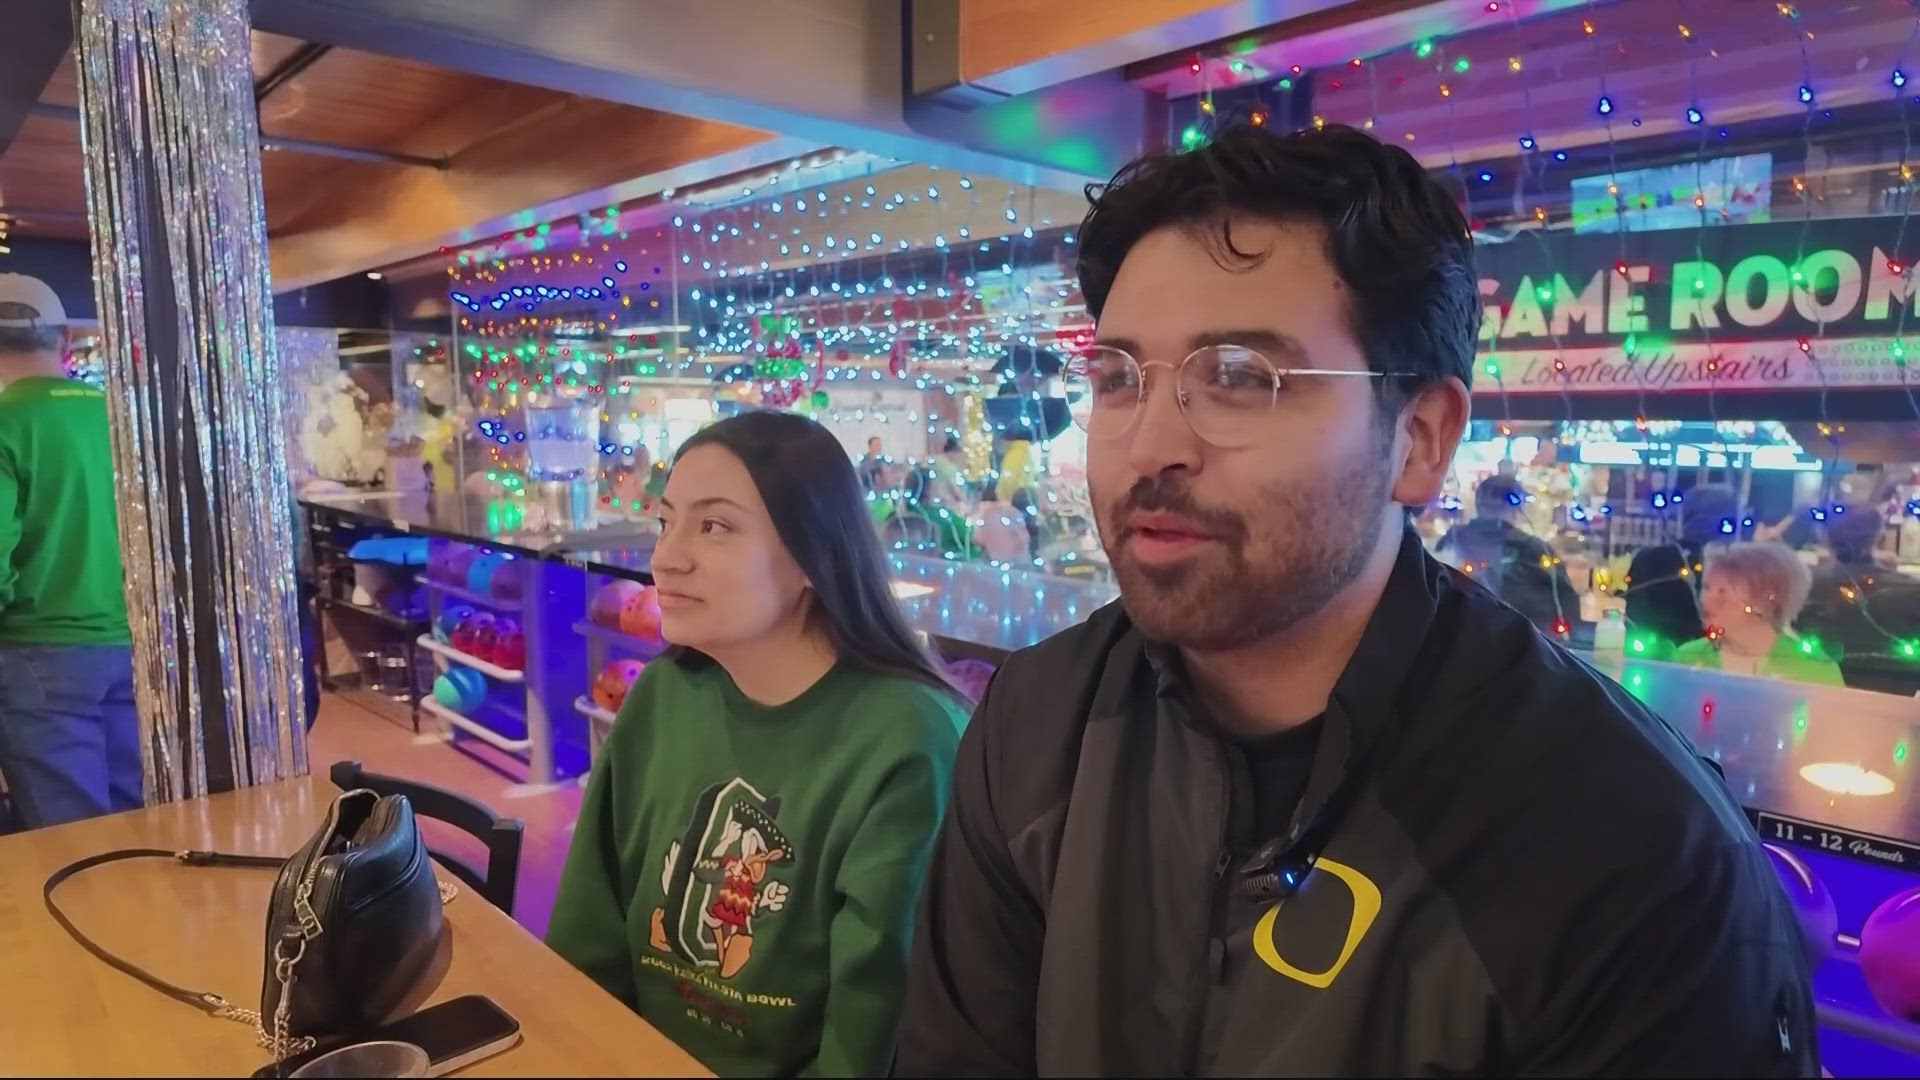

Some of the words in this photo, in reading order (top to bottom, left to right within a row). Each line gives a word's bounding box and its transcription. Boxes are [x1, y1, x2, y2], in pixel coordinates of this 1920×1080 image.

[1477, 264, 1650, 340] GAME
[1670, 245, 1920, 330] ROOM
[1521, 353, 1637, 386] Located
[1640, 351, 1794, 394] Upstairs
[1775, 822, 1795, 841] 11
[1819, 832, 1843, 852] 12
[1848, 840, 1906, 863] Pounds
[746, 993, 797, 1007] BOWL
